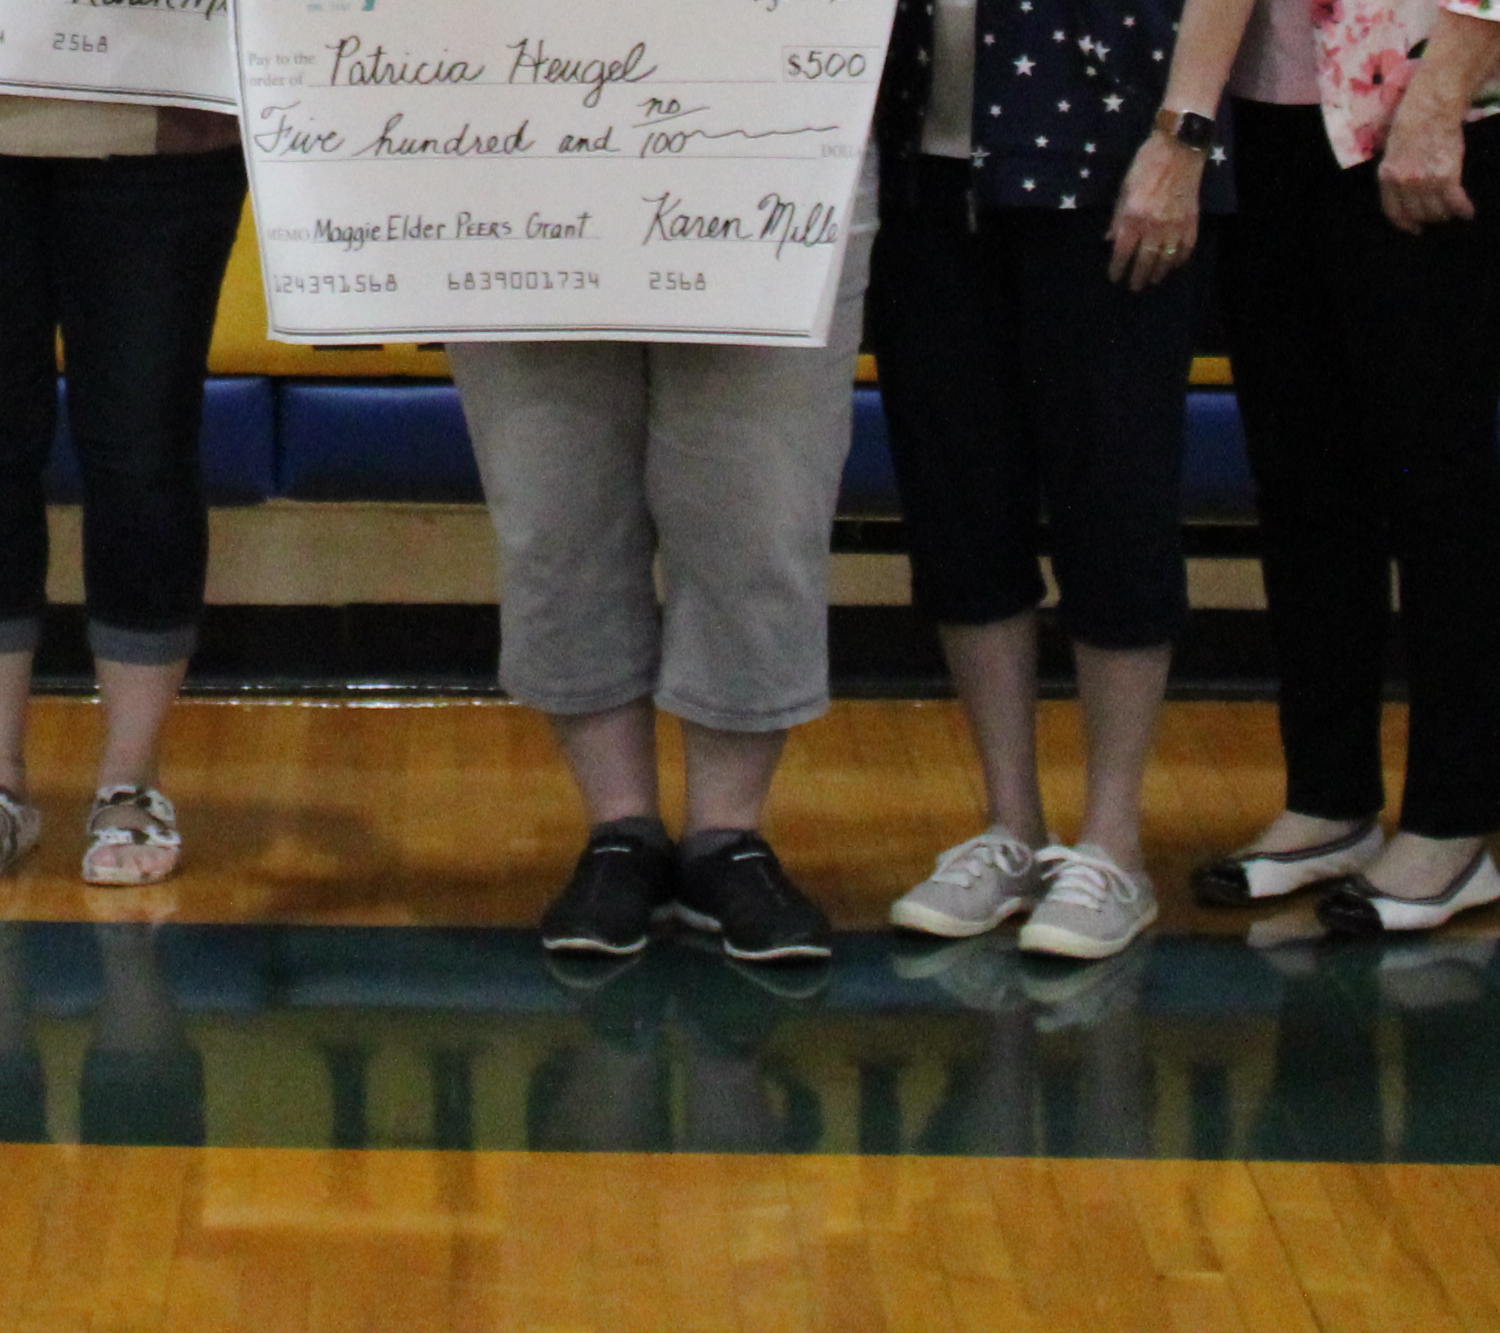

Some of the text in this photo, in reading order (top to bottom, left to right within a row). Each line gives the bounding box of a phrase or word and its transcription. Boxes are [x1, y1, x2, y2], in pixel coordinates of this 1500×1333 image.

[52, 32, 109, 54] 2568
[325, 34, 658, 109] Patricia Heugel
[787, 49, 867, 80] $500
[253, 100, 346, 158] Five
[351, 112, 536, 158] hundred
[558, 125, 621, 155] and
[313, 218, 382, 252] Maggie
[386, 213, 447, 242] Elder
[525, 212, 592, 240] Grant
[641, 191, 753, 247] Karen
[274, 271, 707, 295] 124391568 6839001734 2568
